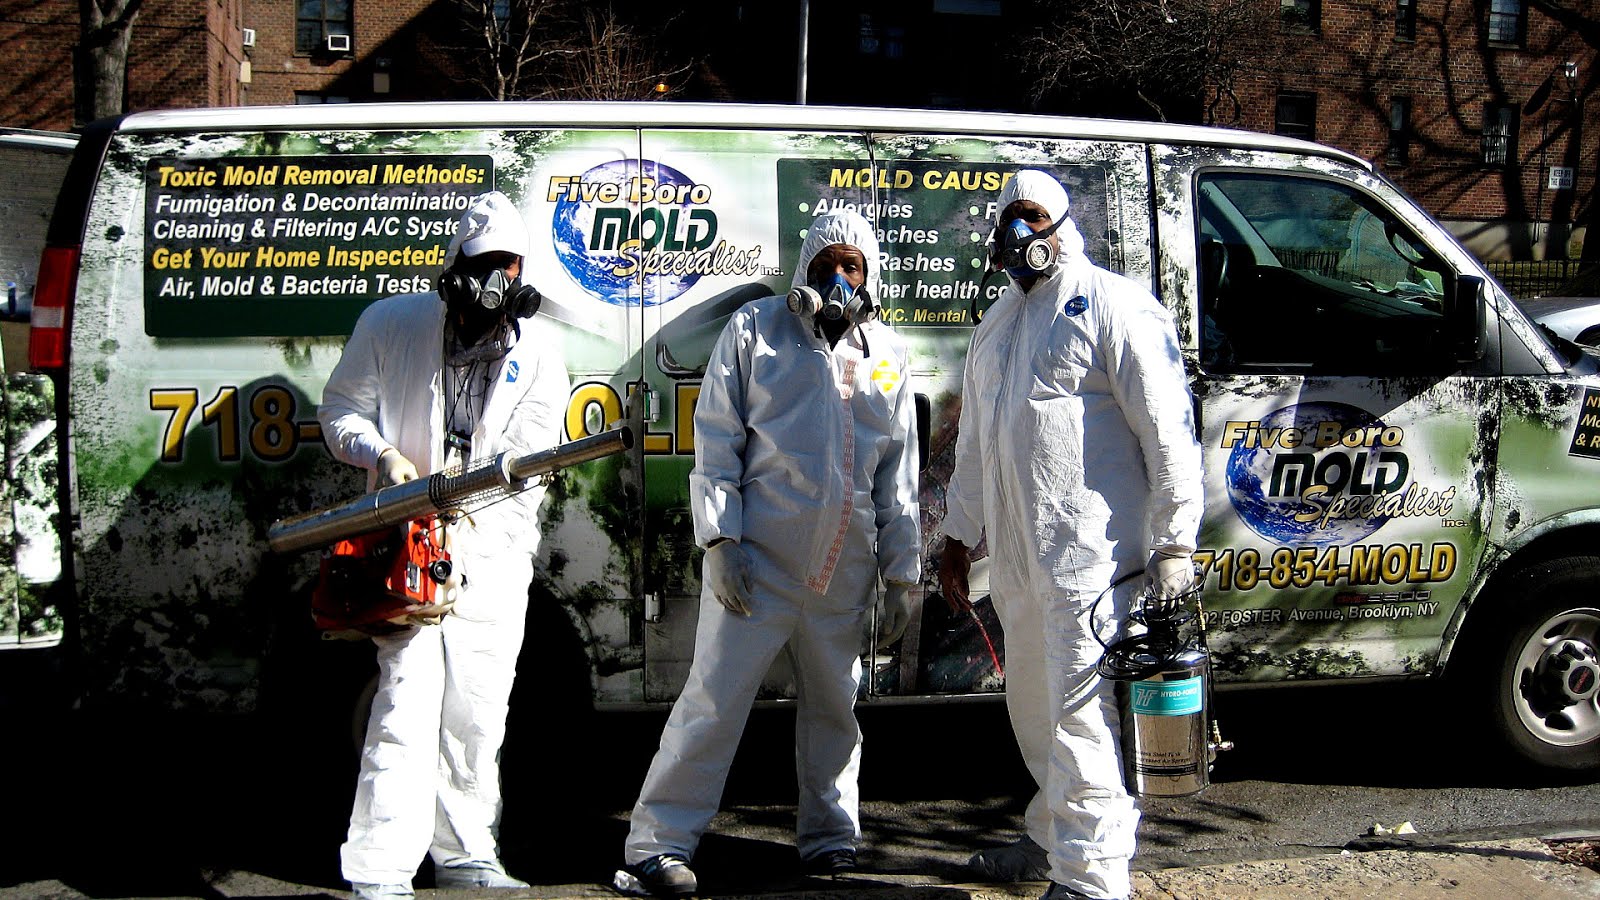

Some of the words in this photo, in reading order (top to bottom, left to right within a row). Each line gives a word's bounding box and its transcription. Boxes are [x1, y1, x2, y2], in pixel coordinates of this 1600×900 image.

[158, 166, 217, 187] Toxic
[223, 165, 278, 186] Mold
[283, 165, 377, 185] Removal
[382, 164, 485, 185] Methods:
[829, 168, 914, 189] MOLD
[547, 176, 619, 203] Five
[629, 177, 712, 204] Boro
[156, 193, 275, 217] Fumigation
[281, 193, 297, 212] &
[153, 219, 244, 243] Cleaning
[251, 218, 266, 238] &
[272, 217, 357, 241] Filtering
[361, 217, 400, 237] A/C
[406, 216, 460, 240] Syste
[589, 206, 718, 252] MOLD
[877, 225, 939, 244] aches
[152, 248, 192, 269] Get
[200, 247, 250, 269] Your
[255, 247, 320, 268] Home
[327, 245, 445, 270] Inspected:
[613, 239, 761, 285] Specialist
[880, 252, 956, 272] Rashes
[160, 276, 196, 300] Air,
[202, 275, 253, 297] Mold
[259, 276, 276, 296] &
[281, 275, 369, 296] Bacteria
[375, 273, 431, 294] Tests
[915, 279, 980, 299] health
[913, 309, 967, 323] Mental
[1221, 421, 1302, 449] Five
[1314, 421, 1404, 449] Boro
[1268, 451, 1410, 498] MOLD
[1295, 482, 1456, 530] Specialist
[1192, 542, 1457, 592] 718-854-MOLD
[1222, 609, 1281, 625] FOSTER
[1288, 606, 1344, 621] Avenue,
[1348, 603, 1414, 620] Brooklyn,
[1417, 602, 1439, 616] NY
